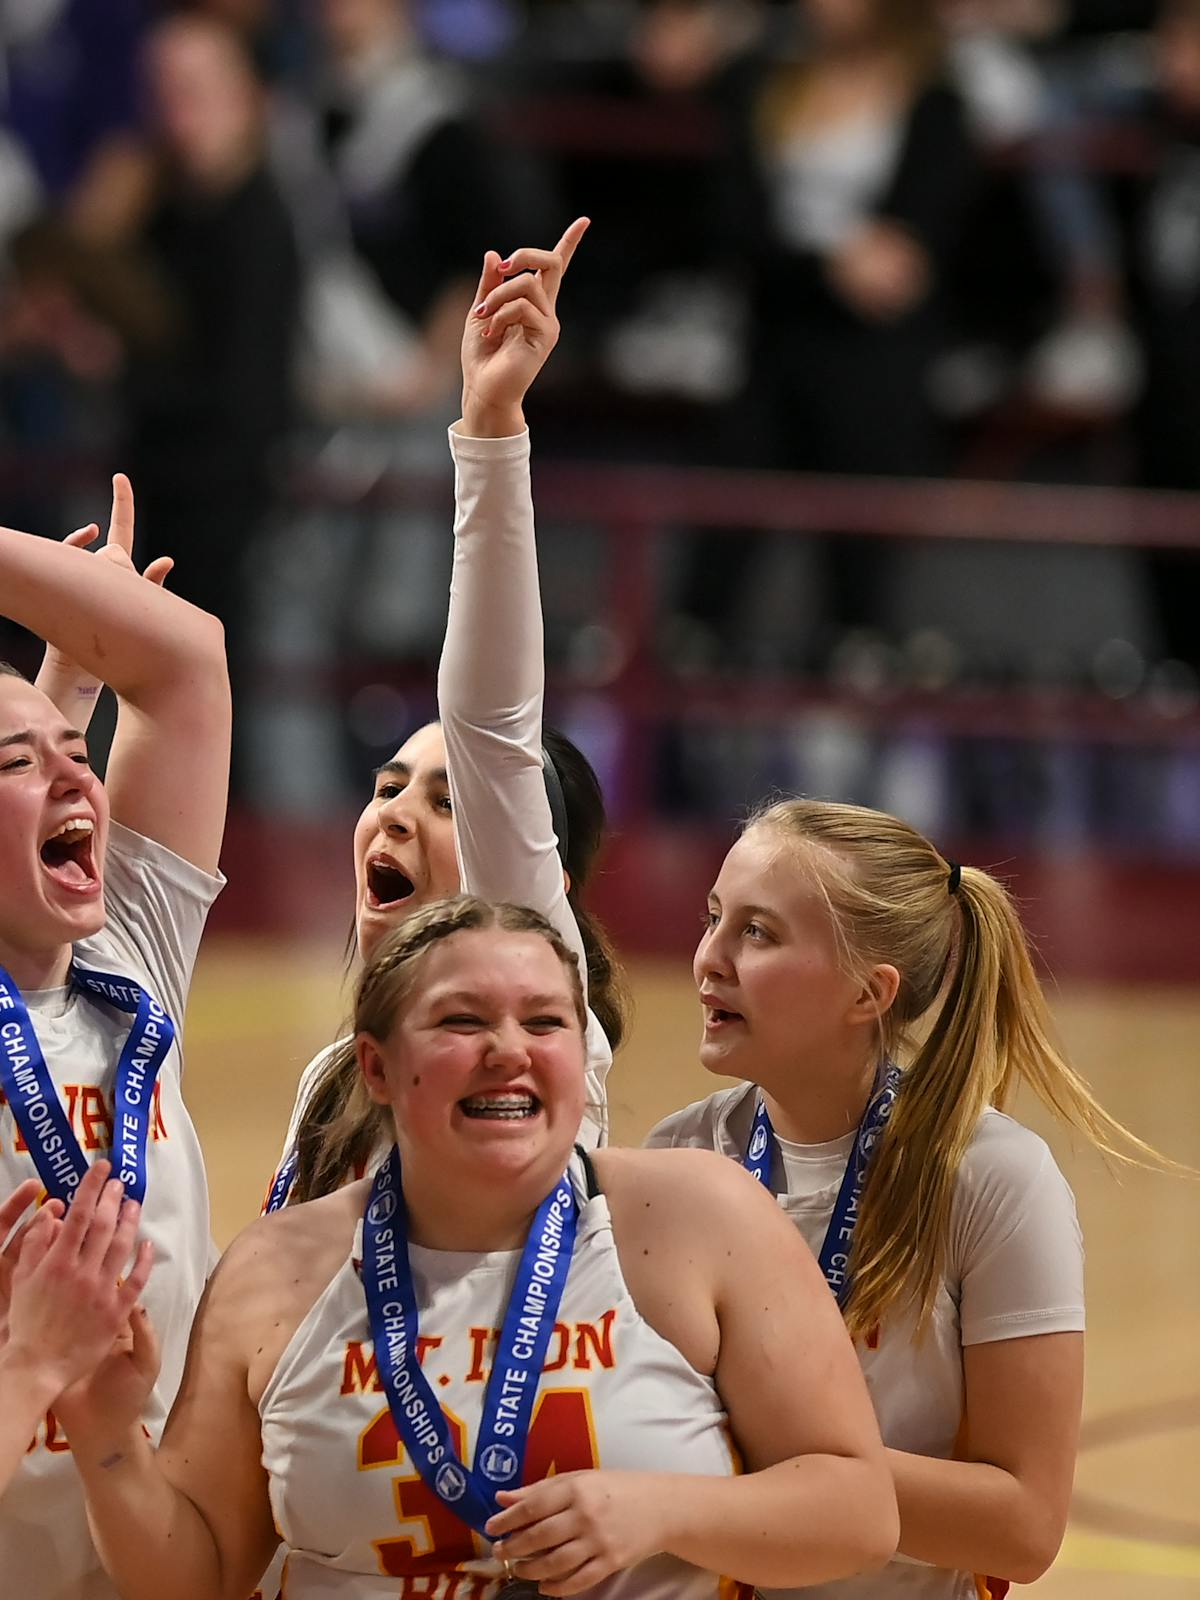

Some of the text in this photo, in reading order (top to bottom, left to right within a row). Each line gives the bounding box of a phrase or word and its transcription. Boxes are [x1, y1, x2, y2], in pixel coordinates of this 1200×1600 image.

[86, 979, 141, 1003] STATE
[120, 1113, 138, 1186] STATE
[374, 1229, 445, 1465] STATE CHAMPIONSHIPS
[494, 1191, 572, 1437] STATE CHAMPIONSHIPS
